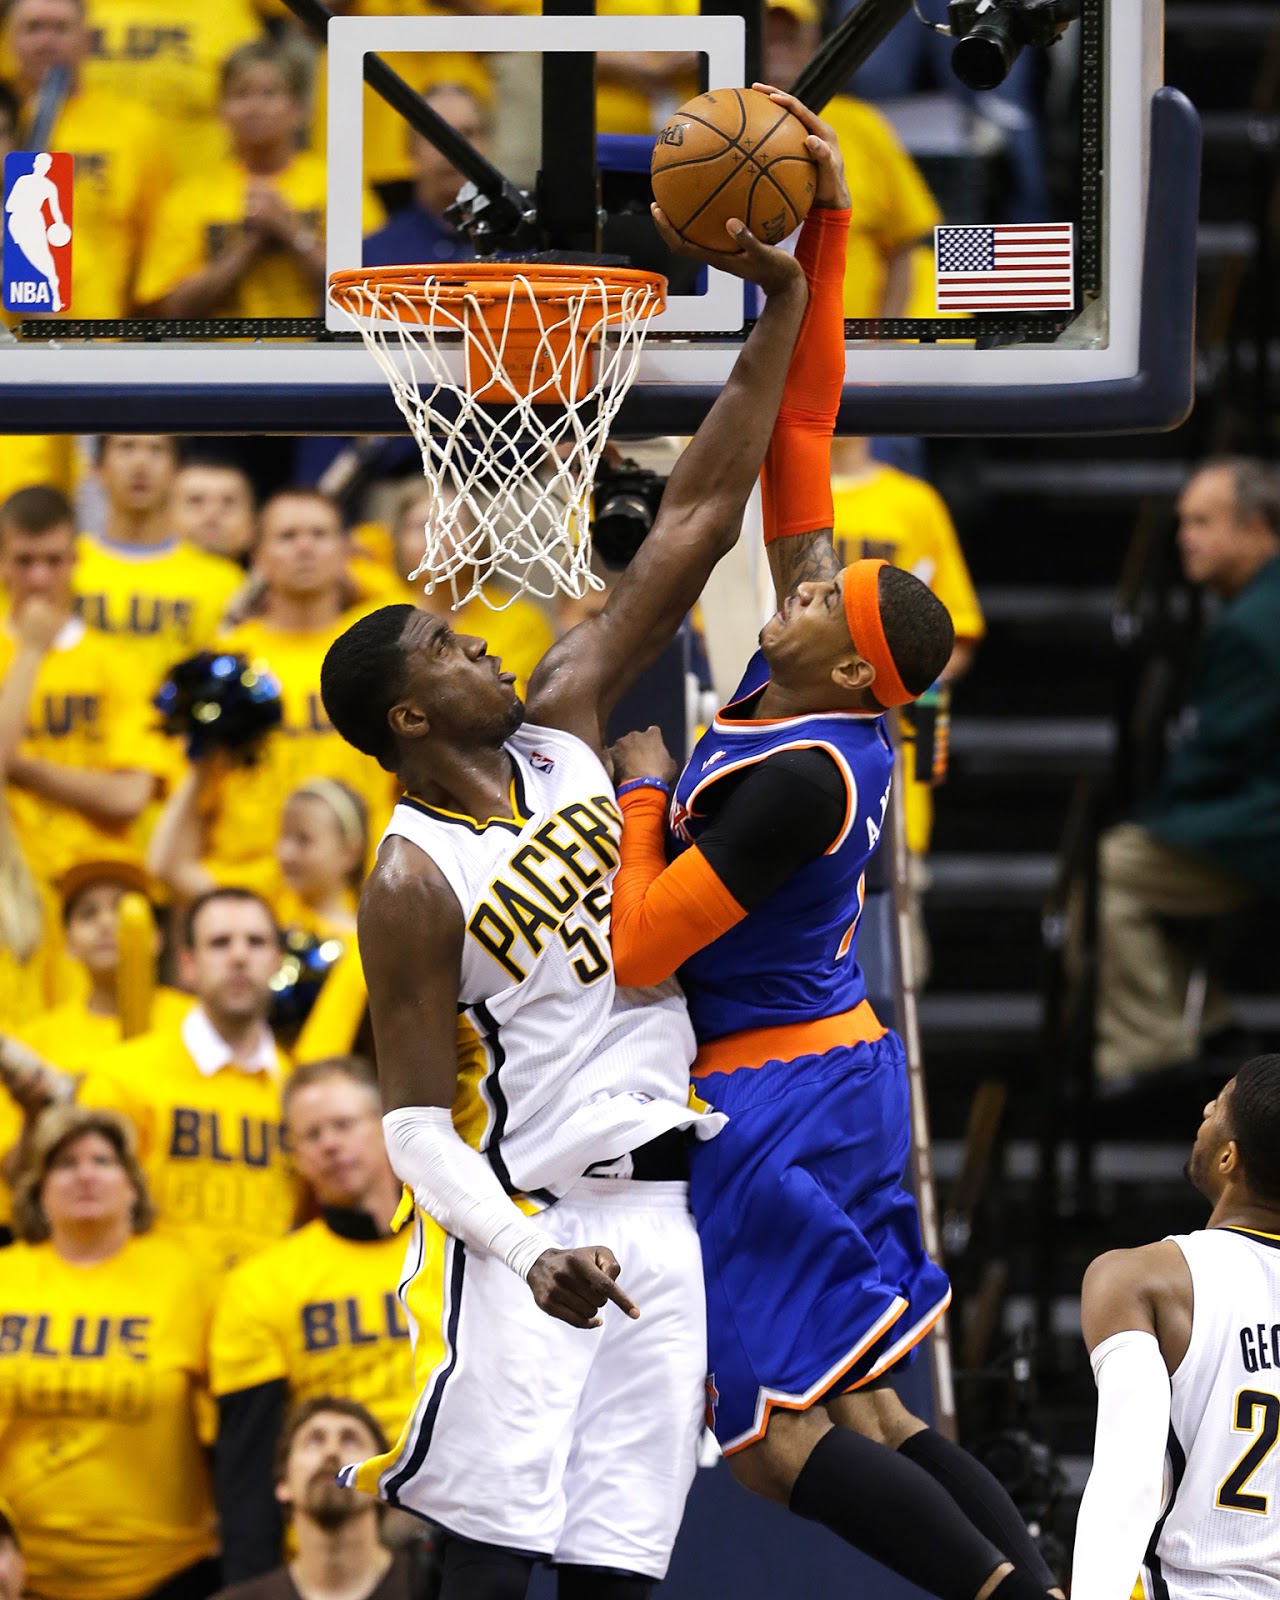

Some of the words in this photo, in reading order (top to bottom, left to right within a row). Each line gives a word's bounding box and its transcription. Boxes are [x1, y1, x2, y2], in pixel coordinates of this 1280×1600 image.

[10, 282, 50, 303] NBA
[0, 1313, 151, 1363] BLUE
[1213, 1387, 1280, 1515] 2
